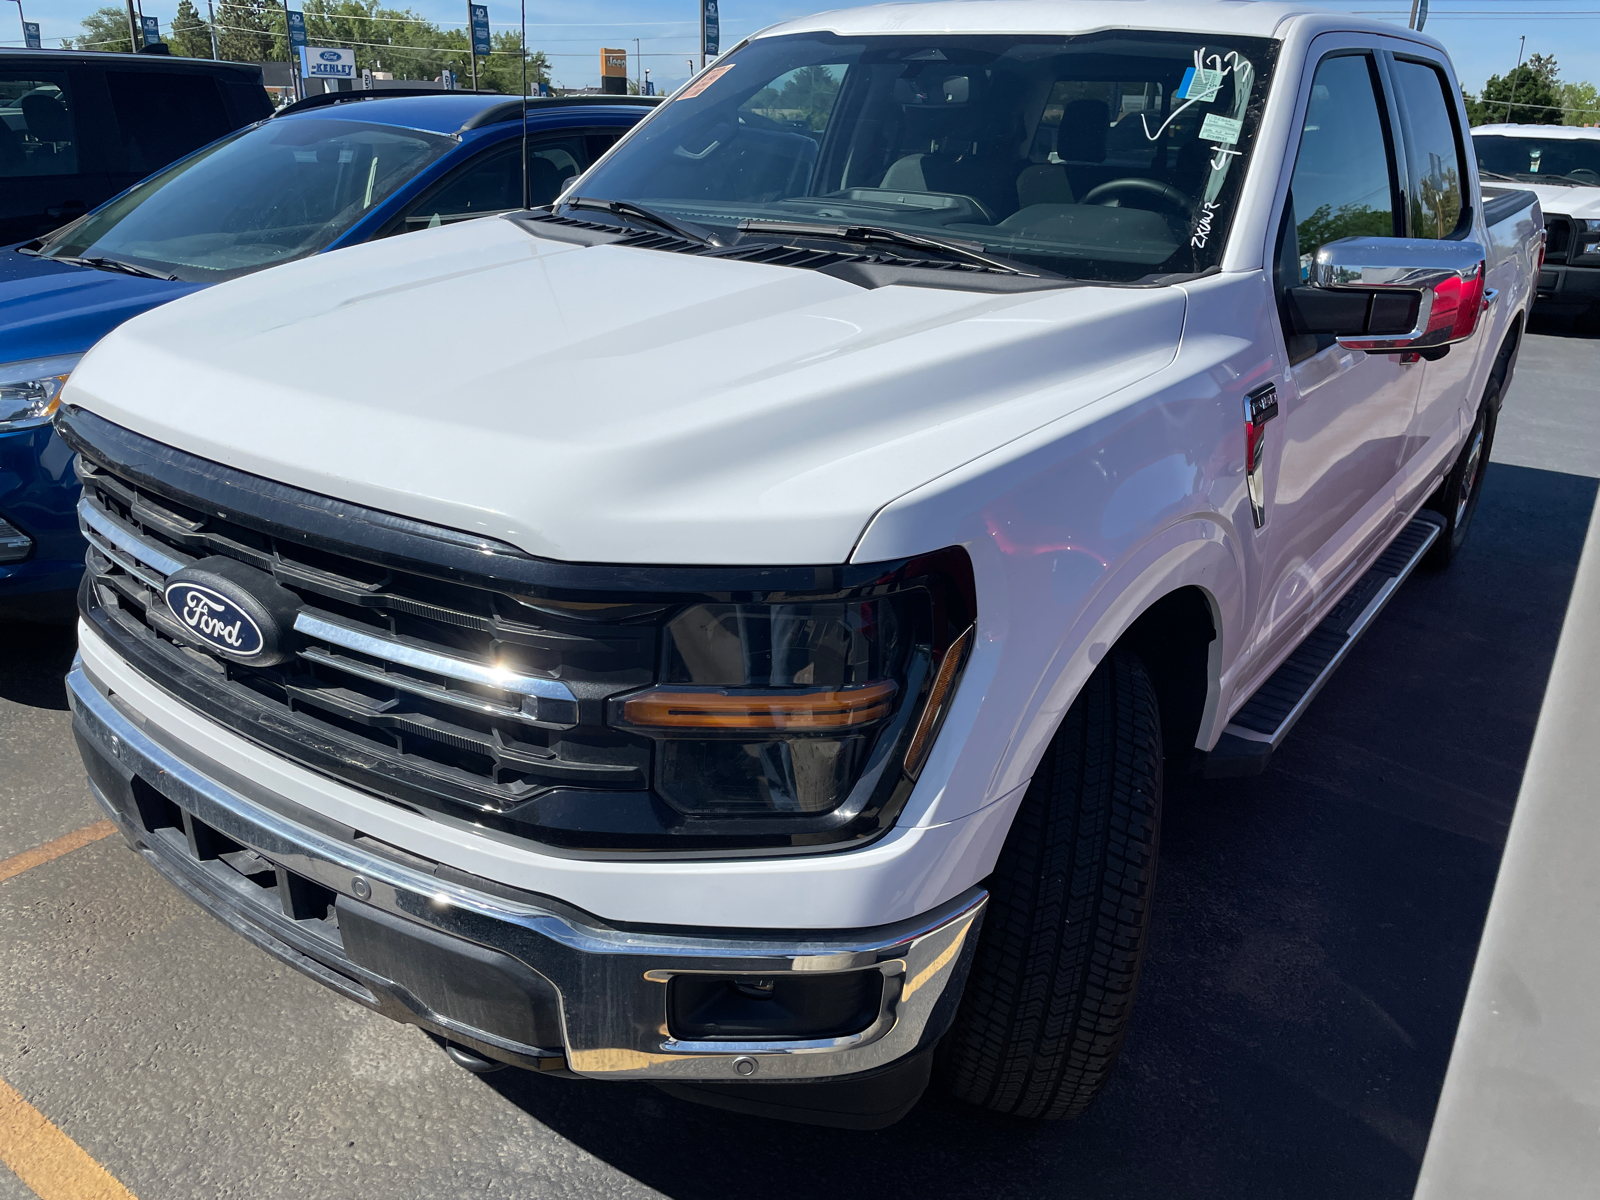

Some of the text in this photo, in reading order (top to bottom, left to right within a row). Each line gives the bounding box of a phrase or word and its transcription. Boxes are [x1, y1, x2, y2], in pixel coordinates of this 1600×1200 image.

[323, 52, 338, 60] Ford
[607, 56, 626, 69] Jeep
[316, 63, 353, 76] KENLEY
[184, 591, 242, 647] Ford
